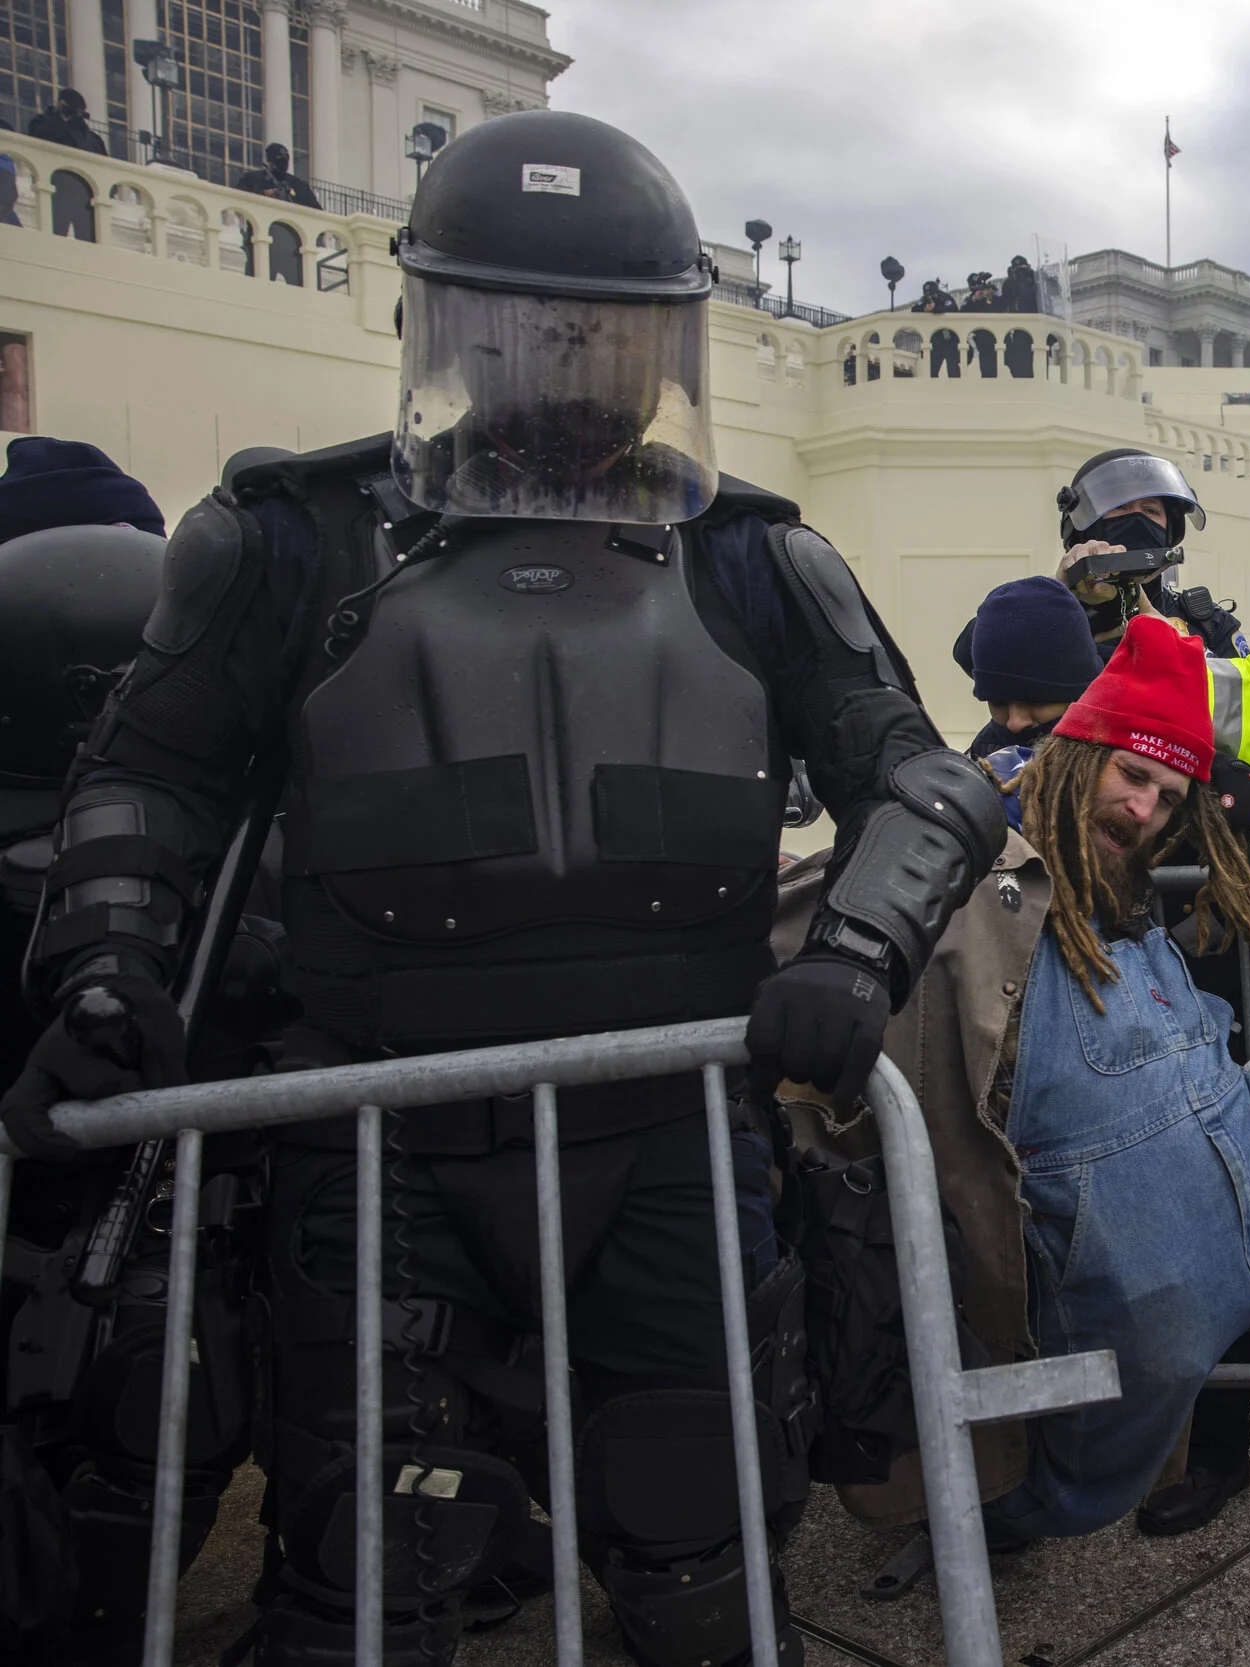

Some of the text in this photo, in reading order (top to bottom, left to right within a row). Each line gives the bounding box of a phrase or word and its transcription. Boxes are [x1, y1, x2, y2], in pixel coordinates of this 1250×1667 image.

[1130, 732, 1164, 747] MAKE
[1133, 742, 1195, 774] GREAT AGAIN
